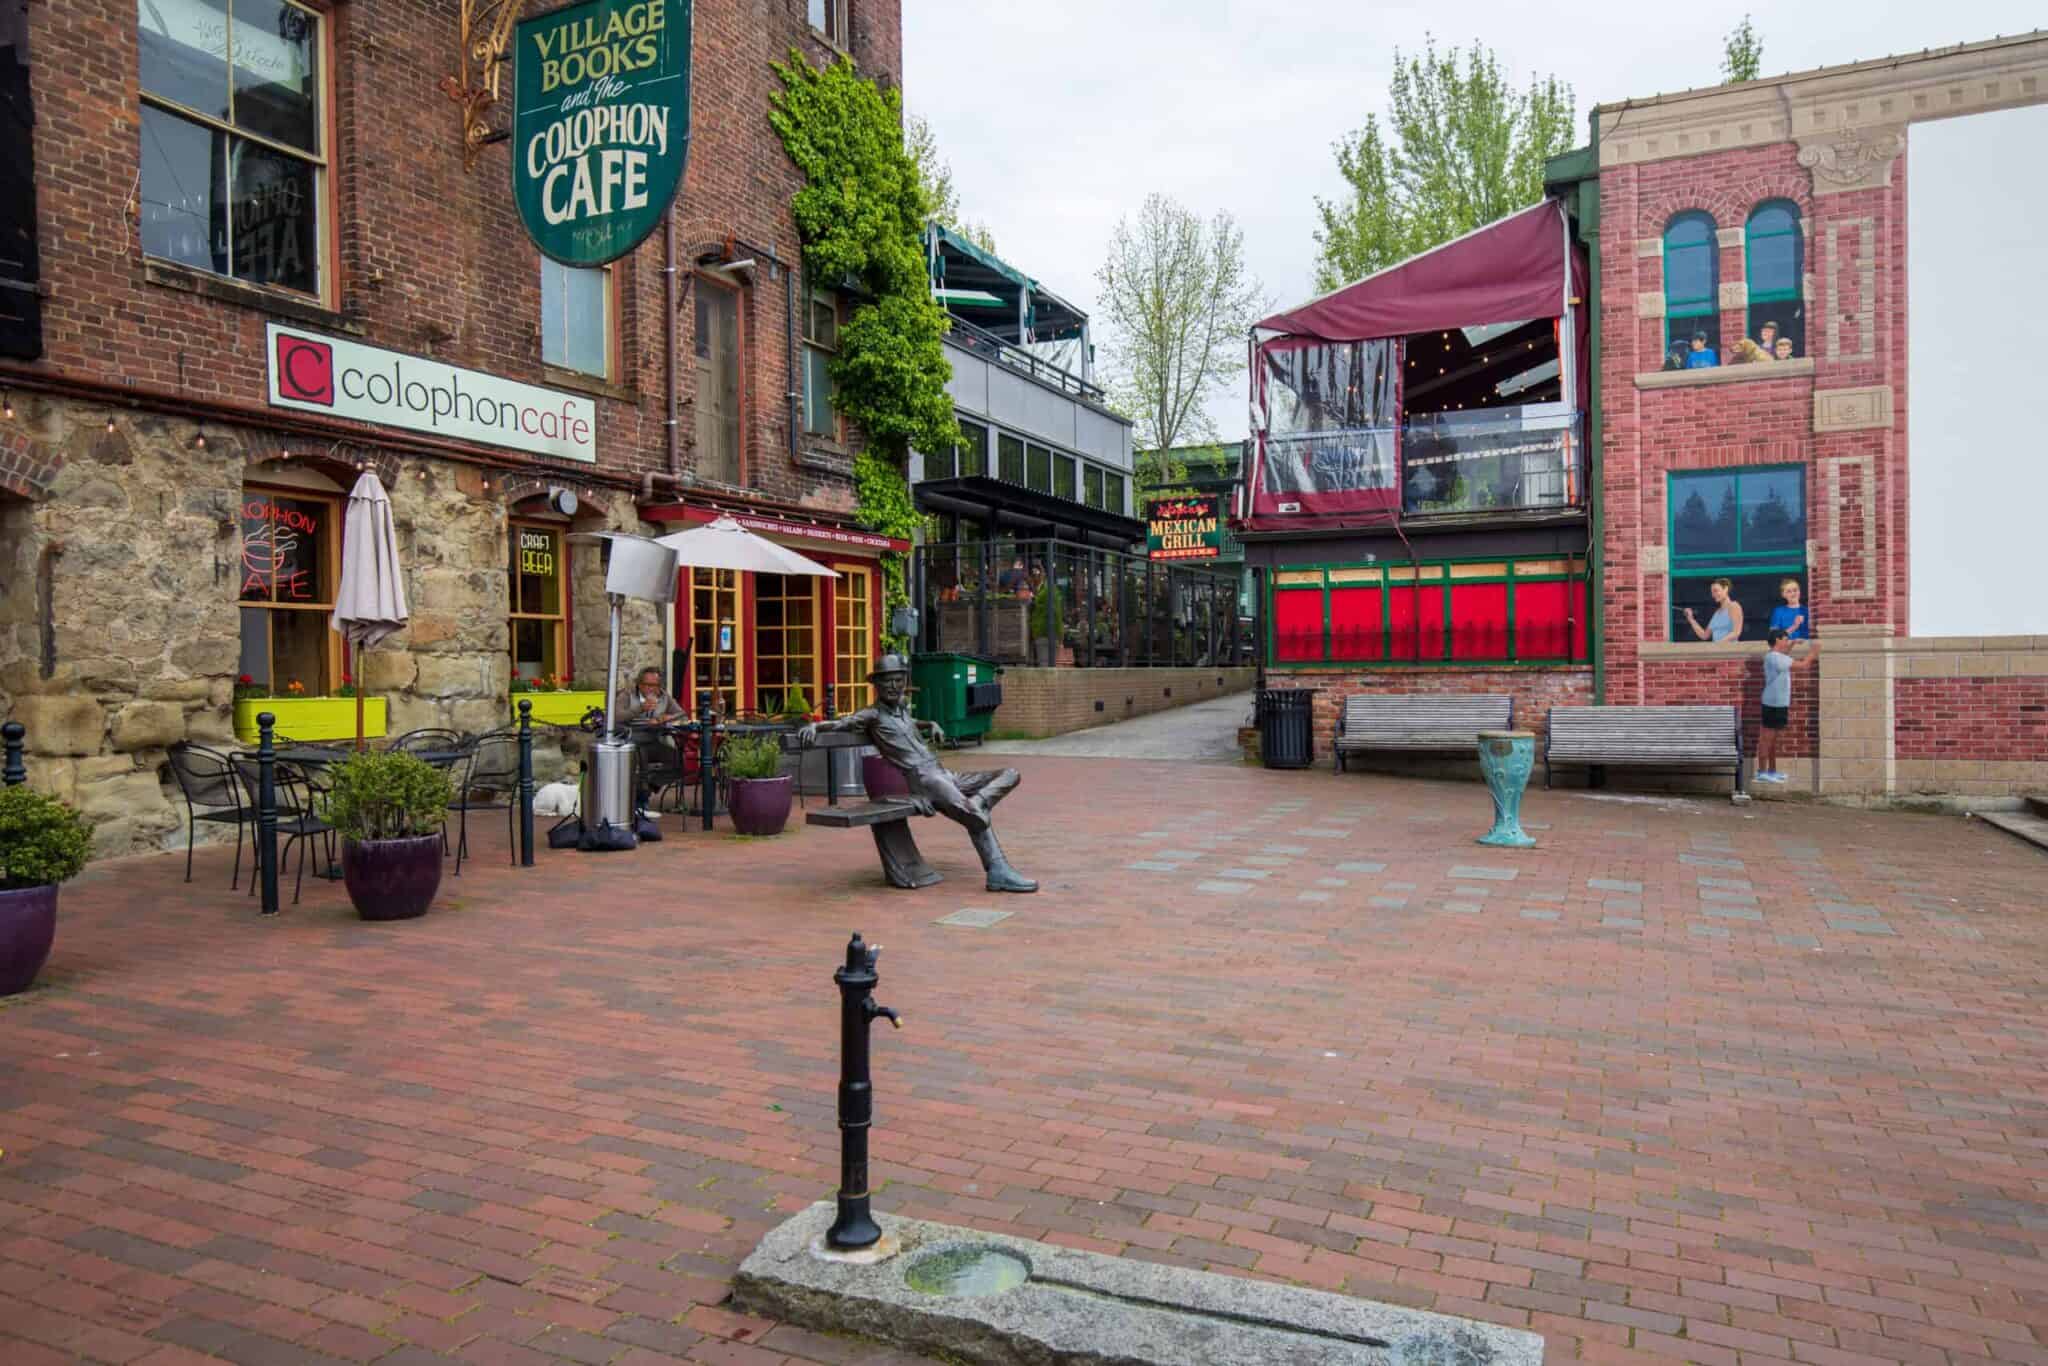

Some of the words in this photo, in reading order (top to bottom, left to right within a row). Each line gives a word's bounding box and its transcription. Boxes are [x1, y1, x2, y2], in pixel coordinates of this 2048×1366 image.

[533, 0, 665, 60] VILLAGE
[541, 35, 657, 93] BOOKS
[560, 82, 592, 112] and
[594, 76, 632, 104] The
[527, 103, 669, 179] COLOPHON
[541, 149, 649, 225] CAFE
[284, 344, 327, 397] C
[341, 360, 590, 445] colophoncafe
[521, 533, 549, 551] CRAFT
[1151, 518, 1216, 536] MEXICAN
[1162, 535, 1205, 550] GRILL
[522, 550, 552, 576] BEER
